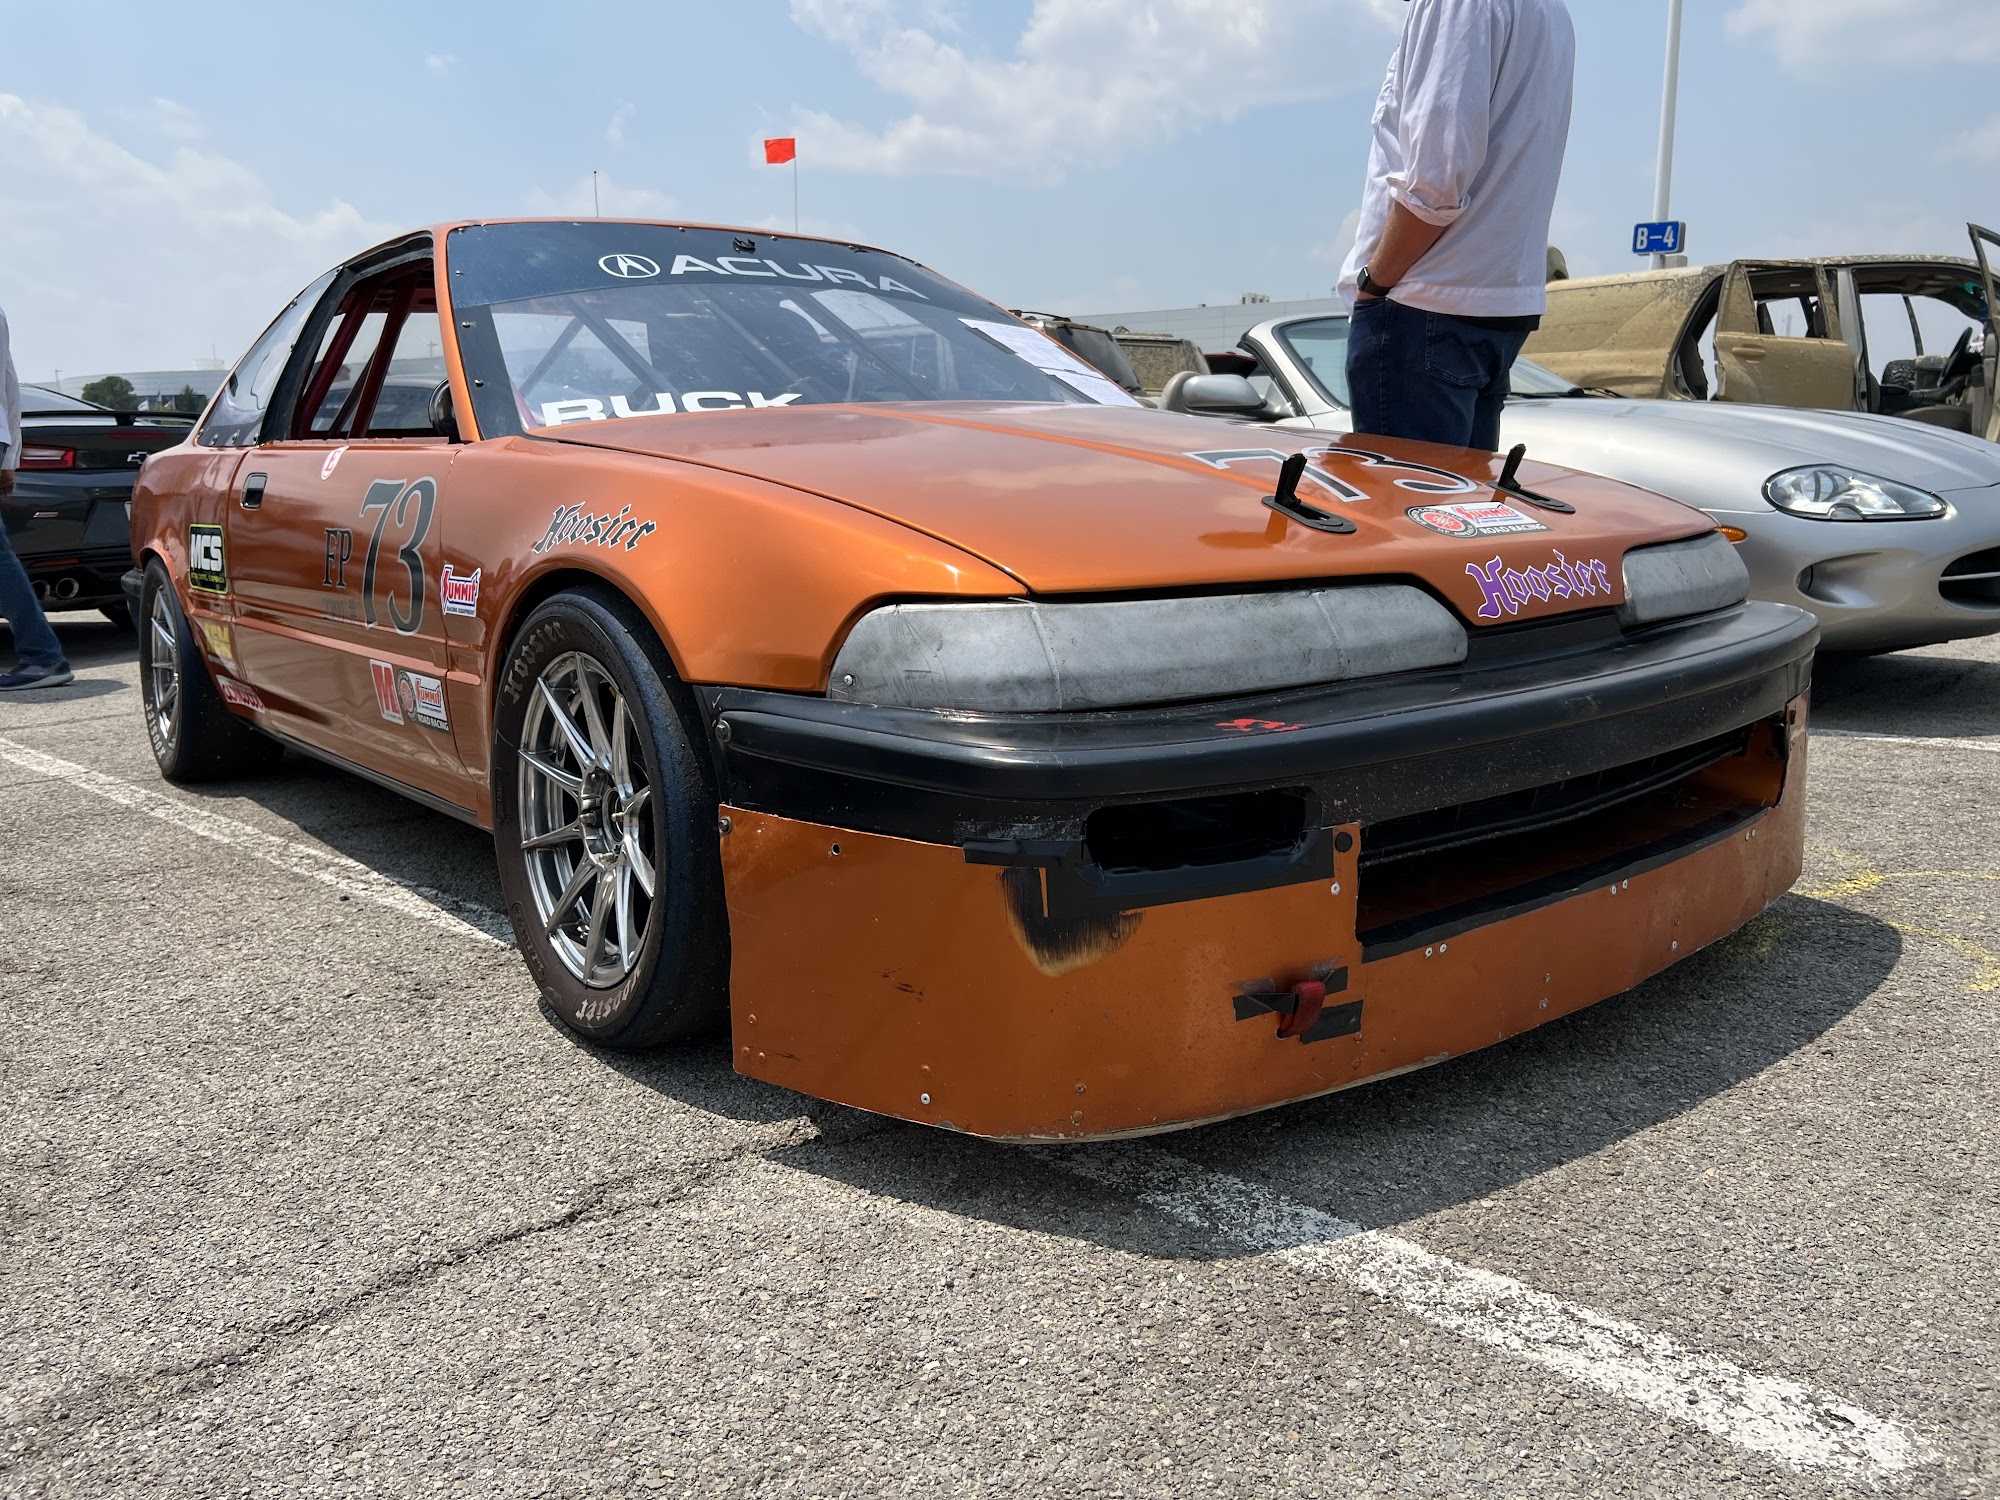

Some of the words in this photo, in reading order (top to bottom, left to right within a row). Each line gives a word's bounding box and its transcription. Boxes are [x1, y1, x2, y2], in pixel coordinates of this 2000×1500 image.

[1636, 225, 1675, 250] B-4
[670, 250, 930, 300] ACURA
[1182, 446, 1478, 502] 73
[190, 533, 223, 572] MCS
[532, 501, 657, 554] Hoosier
[1479, 526, 1511, 535] ROAD
[1508, 523, 1547, 532] RACING
[322, 527, 353, 589] FP
[358, 475, 437, 636] 73
[1465, 549, 1611, 618] Hoosier
